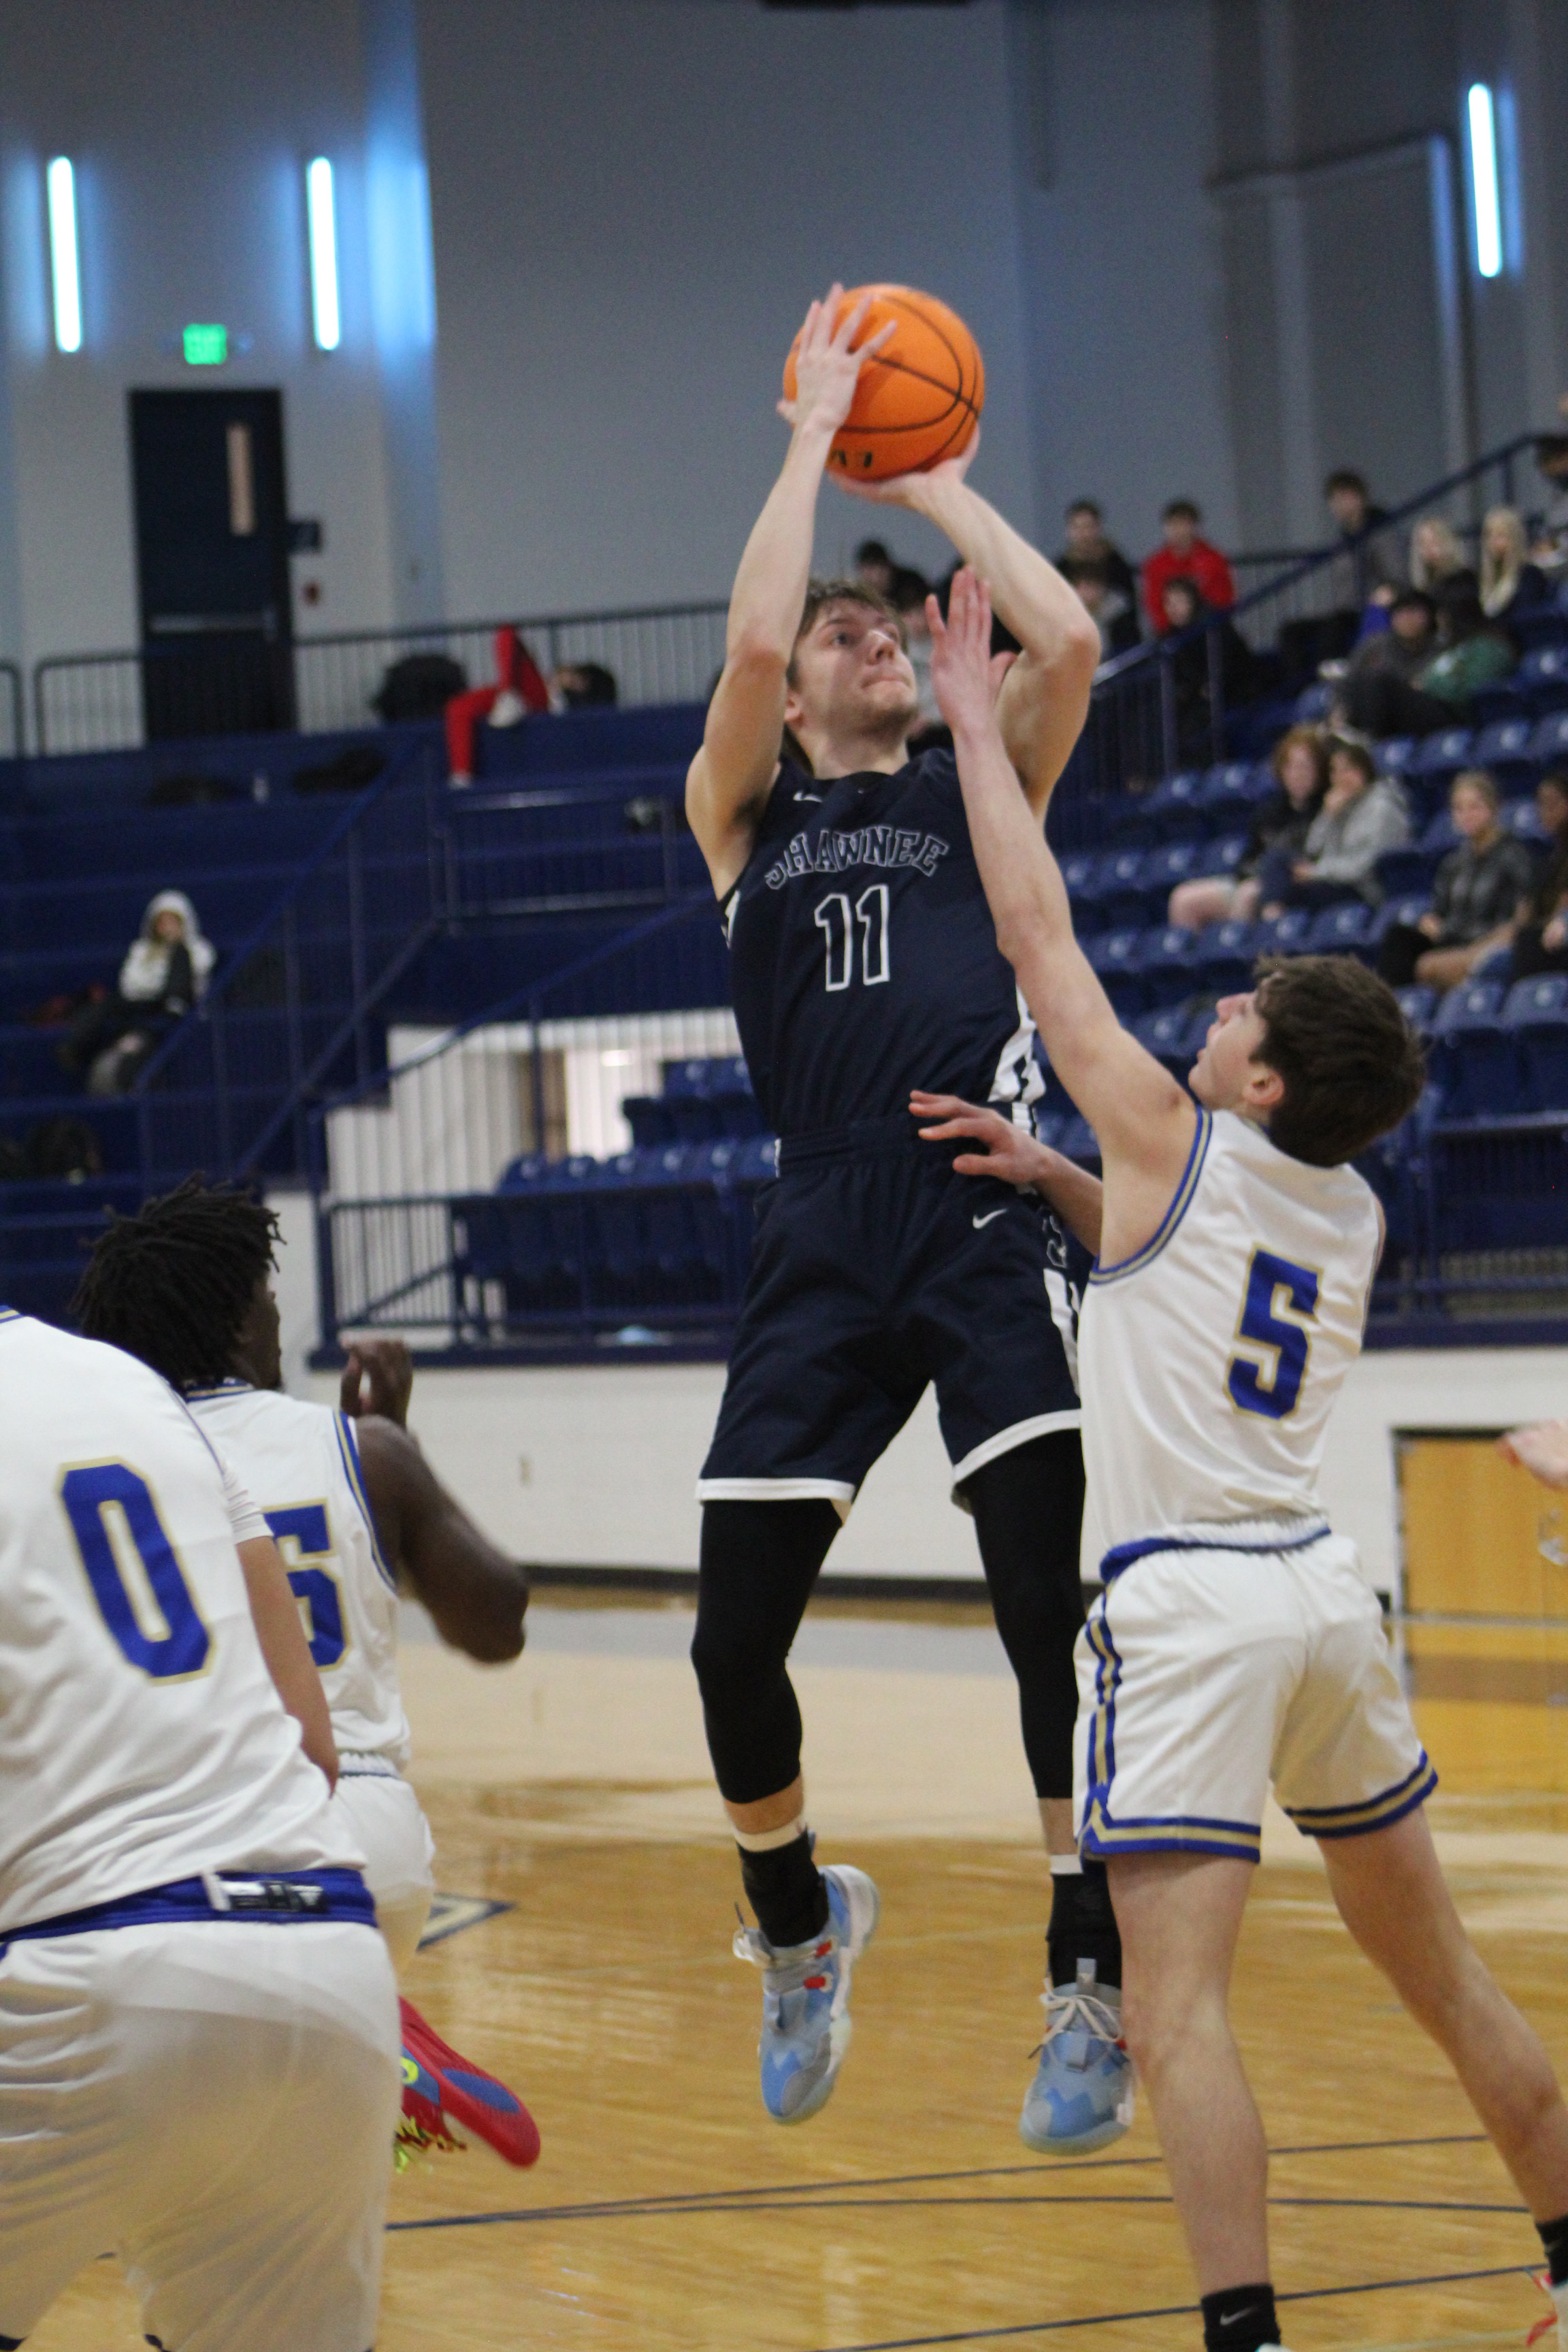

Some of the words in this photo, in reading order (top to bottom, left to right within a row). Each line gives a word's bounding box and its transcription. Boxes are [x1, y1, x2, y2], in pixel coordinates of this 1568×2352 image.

[815, 884, 890, 992] 11
[1223, 1242, 1324, 1422] 5
[54, 1455, 218, 1686] 0
